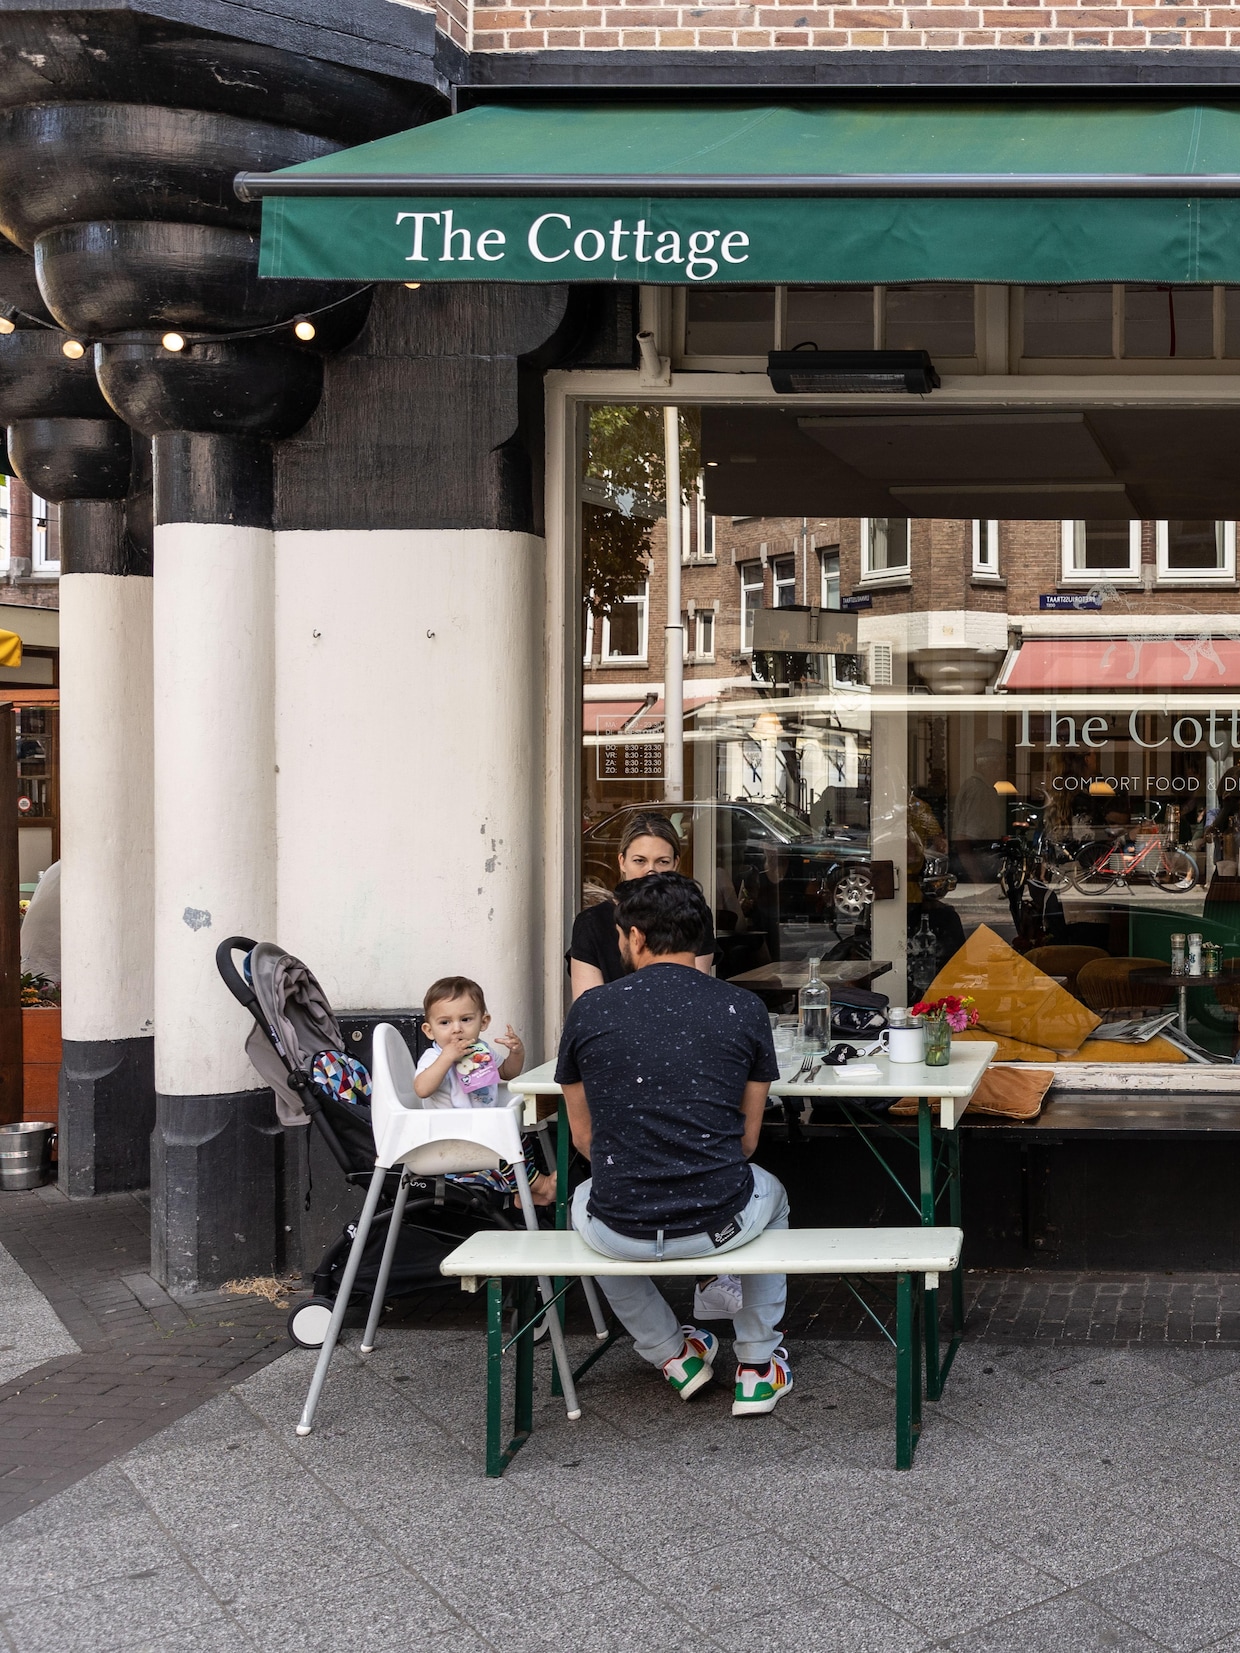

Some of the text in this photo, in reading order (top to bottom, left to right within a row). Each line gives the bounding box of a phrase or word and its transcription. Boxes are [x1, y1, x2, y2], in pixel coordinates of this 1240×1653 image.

[396, 209, 750, 281] The Cottage
[1014, 702, 1110, 748] The
[1052, 776, 1140, 792] COMFORT
[1146, 776, 1200, 792] FOOD
